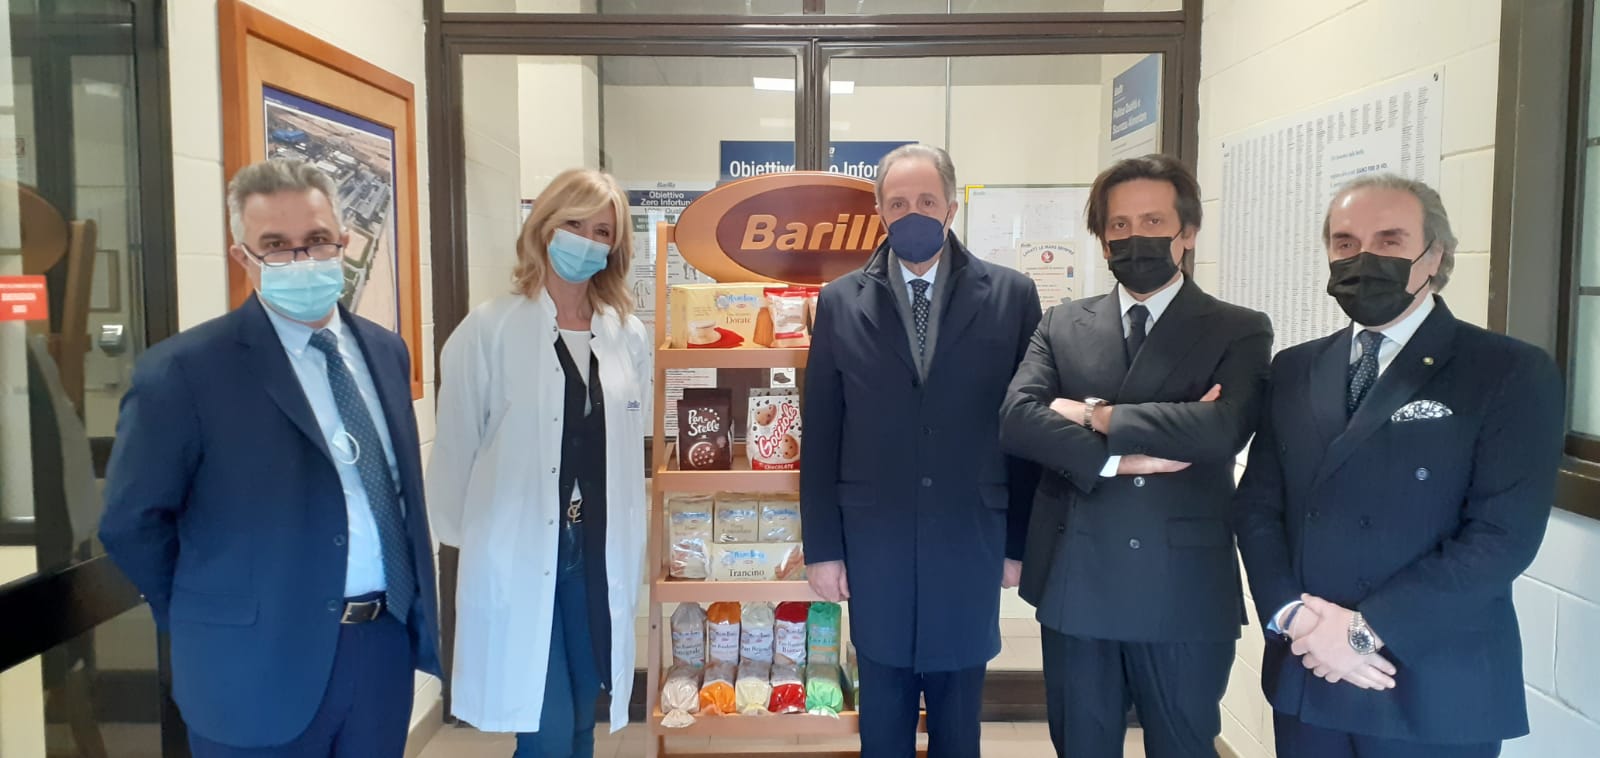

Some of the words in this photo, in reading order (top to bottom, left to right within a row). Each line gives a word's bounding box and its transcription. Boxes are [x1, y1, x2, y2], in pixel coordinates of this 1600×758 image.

[843, 161, 879, 178] Infor
[648, 191, 684, 199] Obiettivo
[640, 198, 659, 206] Zero
[688, 409, 705, 425] Pan
[687, 420, 720, 437] Stelle
[729, 568, 765, 577] Trancino
